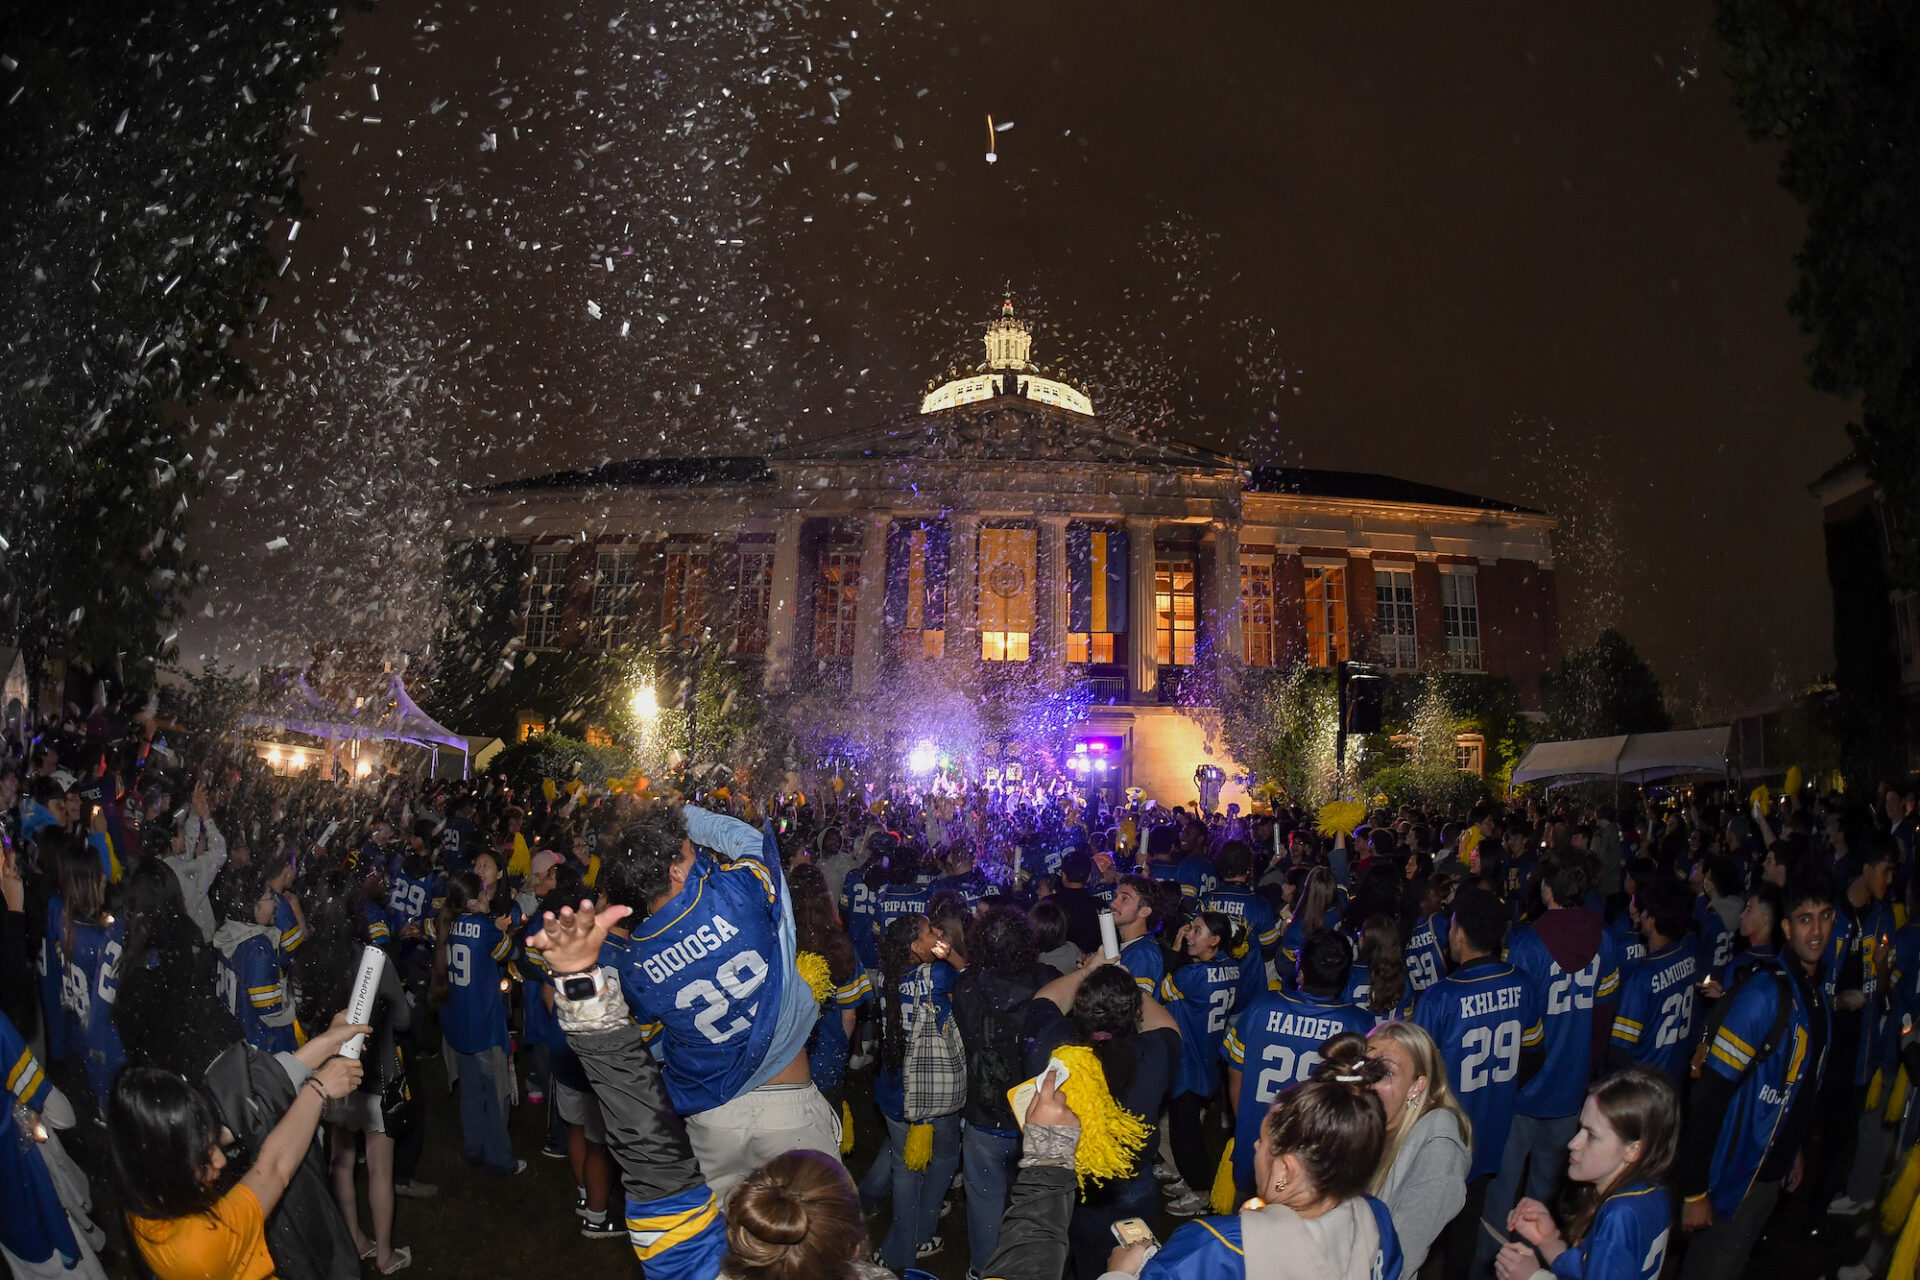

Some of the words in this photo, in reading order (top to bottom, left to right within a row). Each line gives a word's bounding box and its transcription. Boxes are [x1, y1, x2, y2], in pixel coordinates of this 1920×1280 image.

[389, 877, 426, 917] 29
[880, 900, 926, 913] TRIPATHI
[642, 914, 740, 984] GIOIOSA
[359, 966, 374, 1001] POPPERS
[1406, 951, 1439, 991] 29
[1547, 953, 1601, 1015] 29
[675, 950, 769, 1044] 29
[1460, 986, 1522, 1019] KHLEIF
[1656, 984, 1694, 1049] 29
[1265, 1010, 1344, 1041] HAIDER
[1460, 1019, 1522, 1092] 29
[1758, 1084, 1792, 1106] RO
